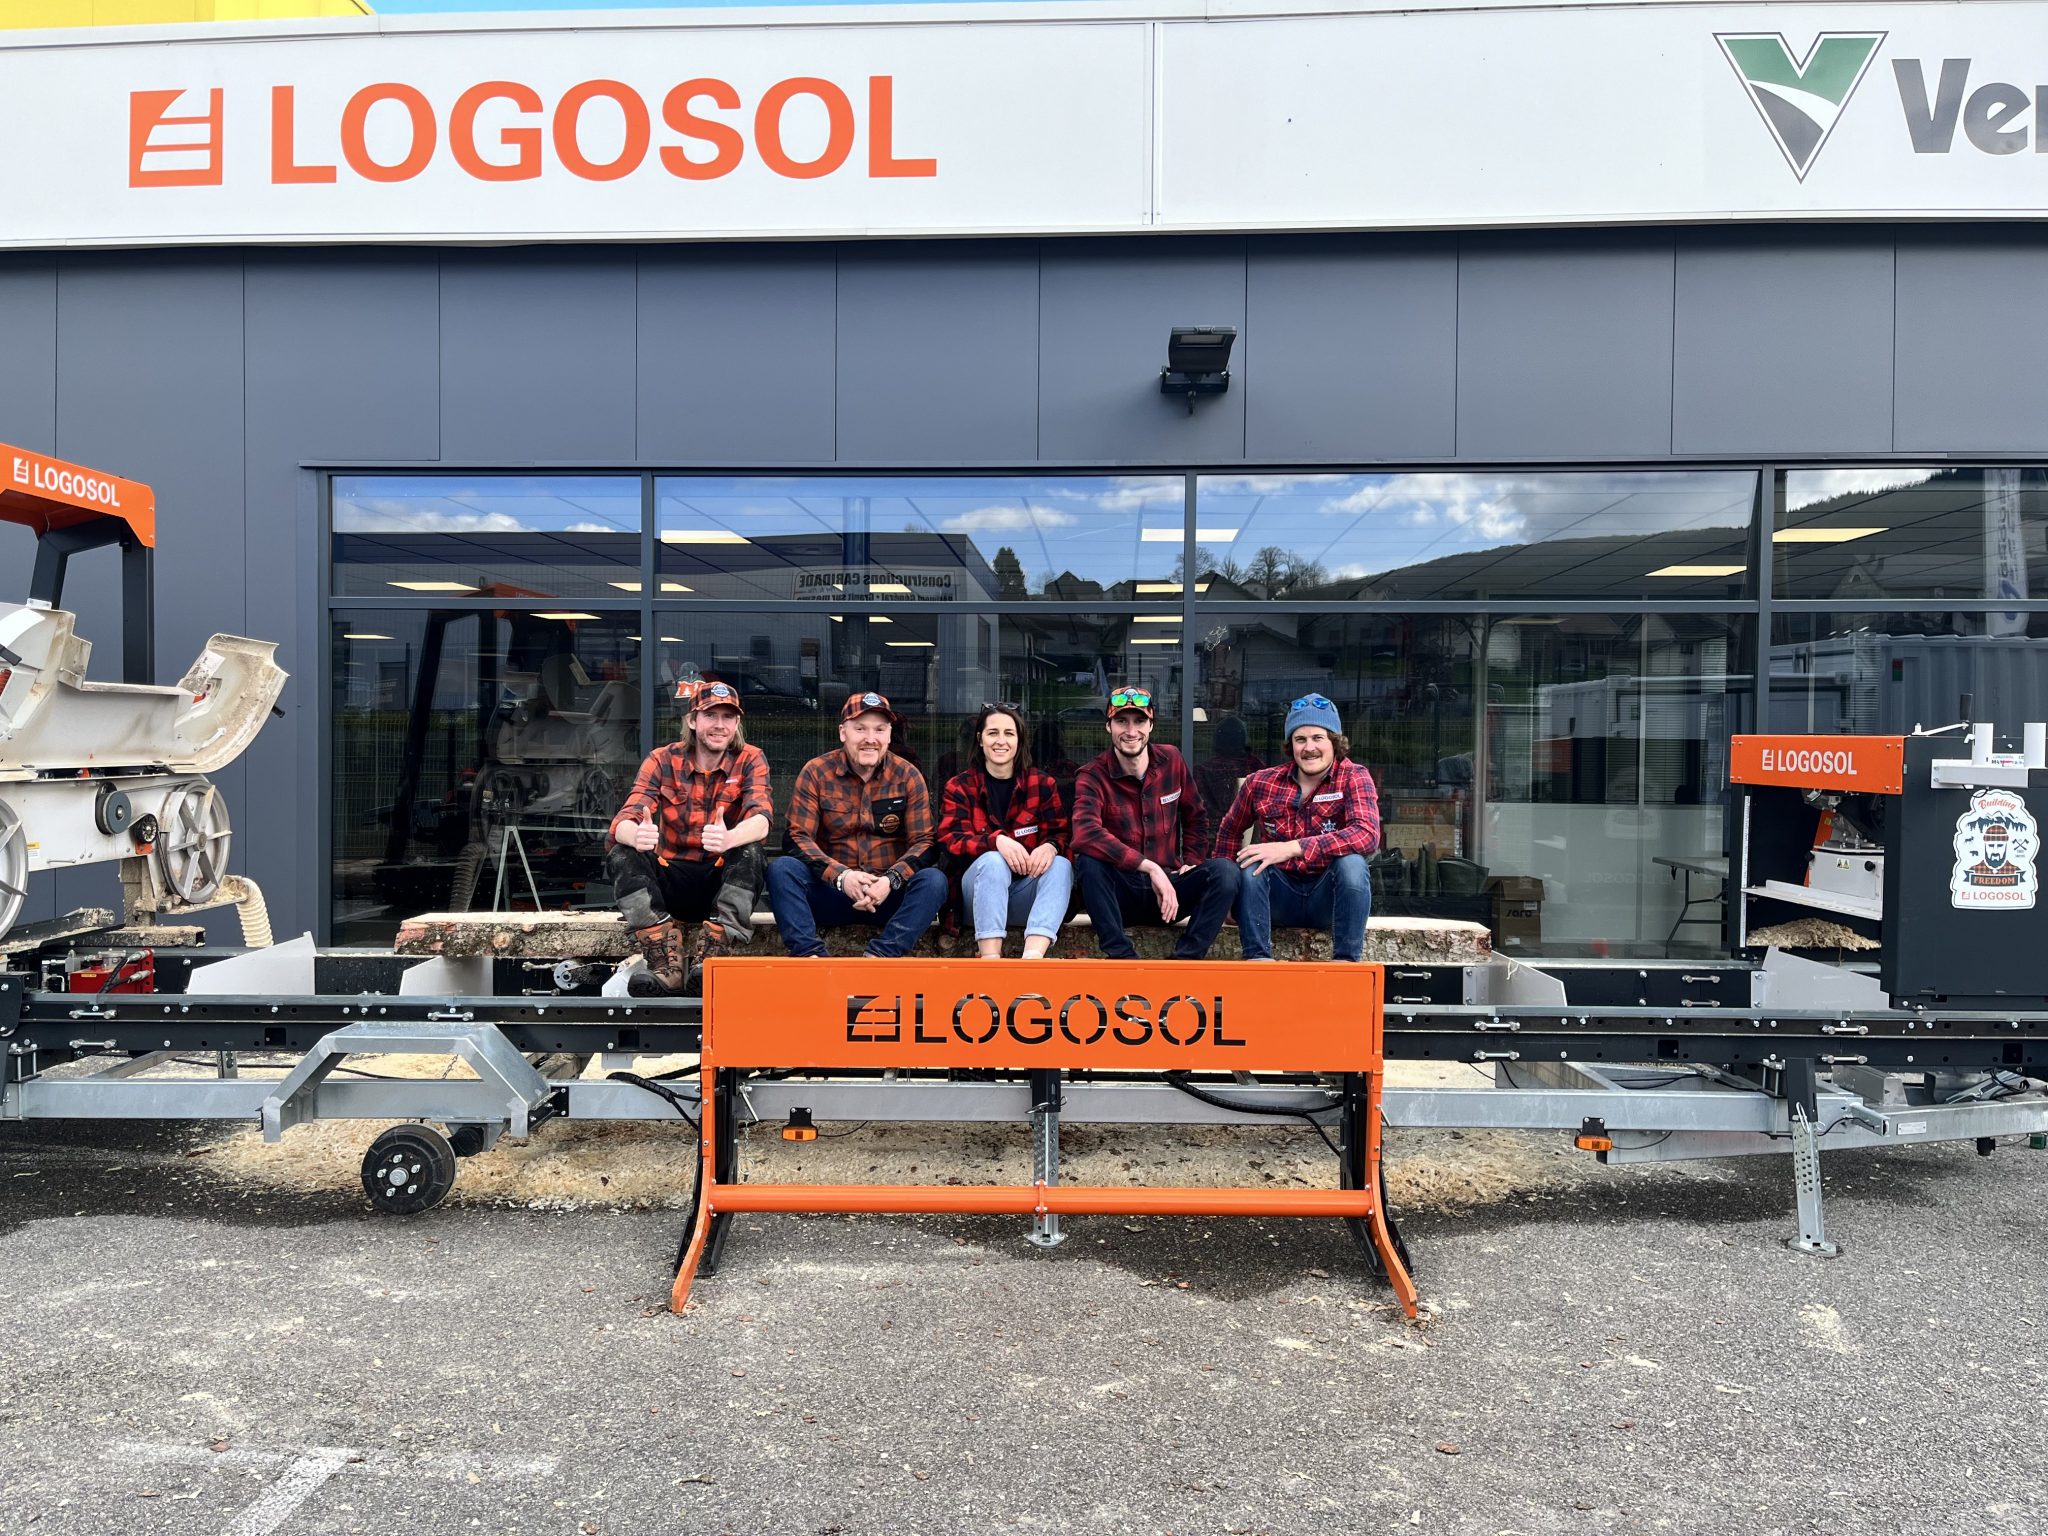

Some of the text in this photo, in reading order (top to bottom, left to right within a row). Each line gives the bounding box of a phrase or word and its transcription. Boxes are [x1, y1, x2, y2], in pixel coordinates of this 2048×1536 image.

[271, 75, 937, 185] LOGOSOL
[34, 462, 120, 507] LOGOSOL
[1777, 750, 1858, 775] LOGOSOL
[1978, 798, 2017, 810] Building
[1973, 874, 2015, 885] FREEDOM
[1973, 891, 2026, 901] LOGOSOL
[914, 993, 1247, 1047] LOGOSOL
